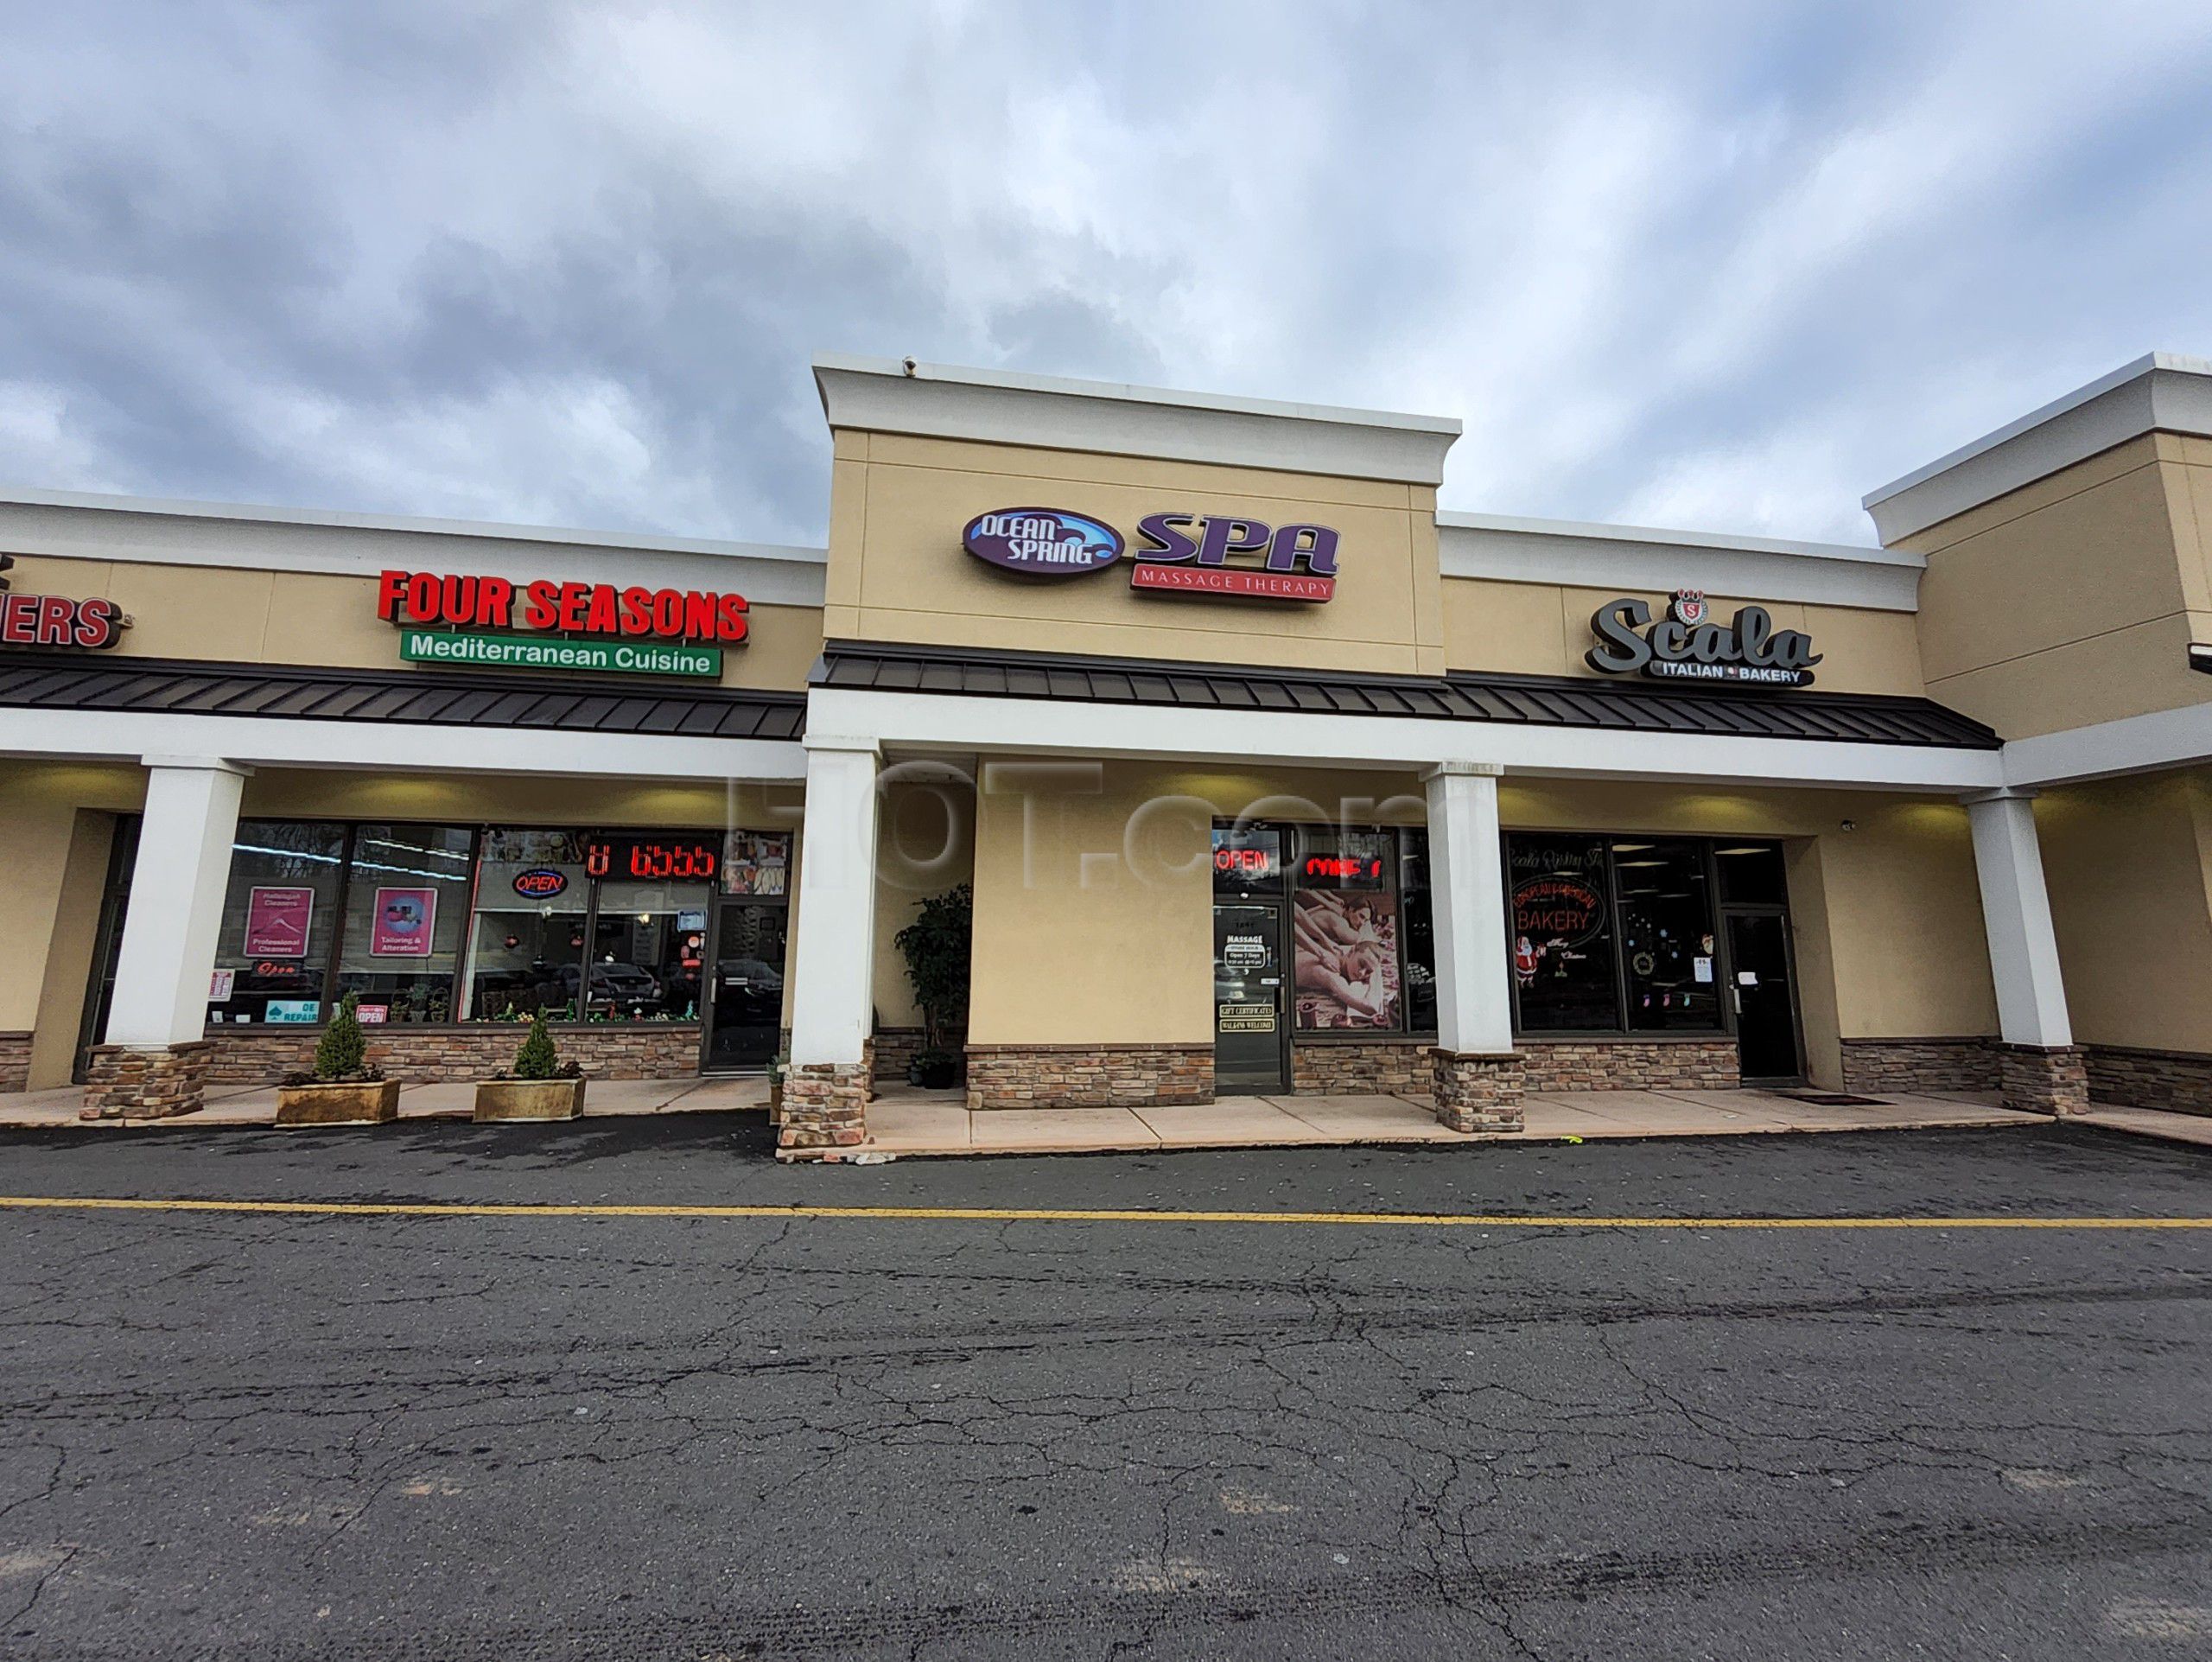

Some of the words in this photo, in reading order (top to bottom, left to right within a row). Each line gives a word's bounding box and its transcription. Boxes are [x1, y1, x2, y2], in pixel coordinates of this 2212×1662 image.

[981, 514, 1057, 540] OCEAN
[1007, 538, 1094, 565] SPRING
[1135, 513, 1341, 575] SPA
[1141, 569, 1234, 589] MASSAGE
[1243, 576, 1331, 596] THERAPY
[378, 570, 515, 627] FOUR
[525, 580, 750, 641] SEASONS
[0, 593, 111, 647] ERS
[1588, 597, 1824, 672] Scala
[410, 634, 608, 668] Mediterranean
[615, 648, 711, 673] Cuisine
[1662, 662, 1724, 678] ITALIAN
[1738, 667, 1801, 683] BAKERY
[1216, 850, 1269, 871] OPEN
[516, 876, 563, 892] OPEN
[1517, 910, 1589, 931] BAKERY
[1227, 934, 1262, 944] MASSAGE
[359, 1012, 384, 1022] OPEN
